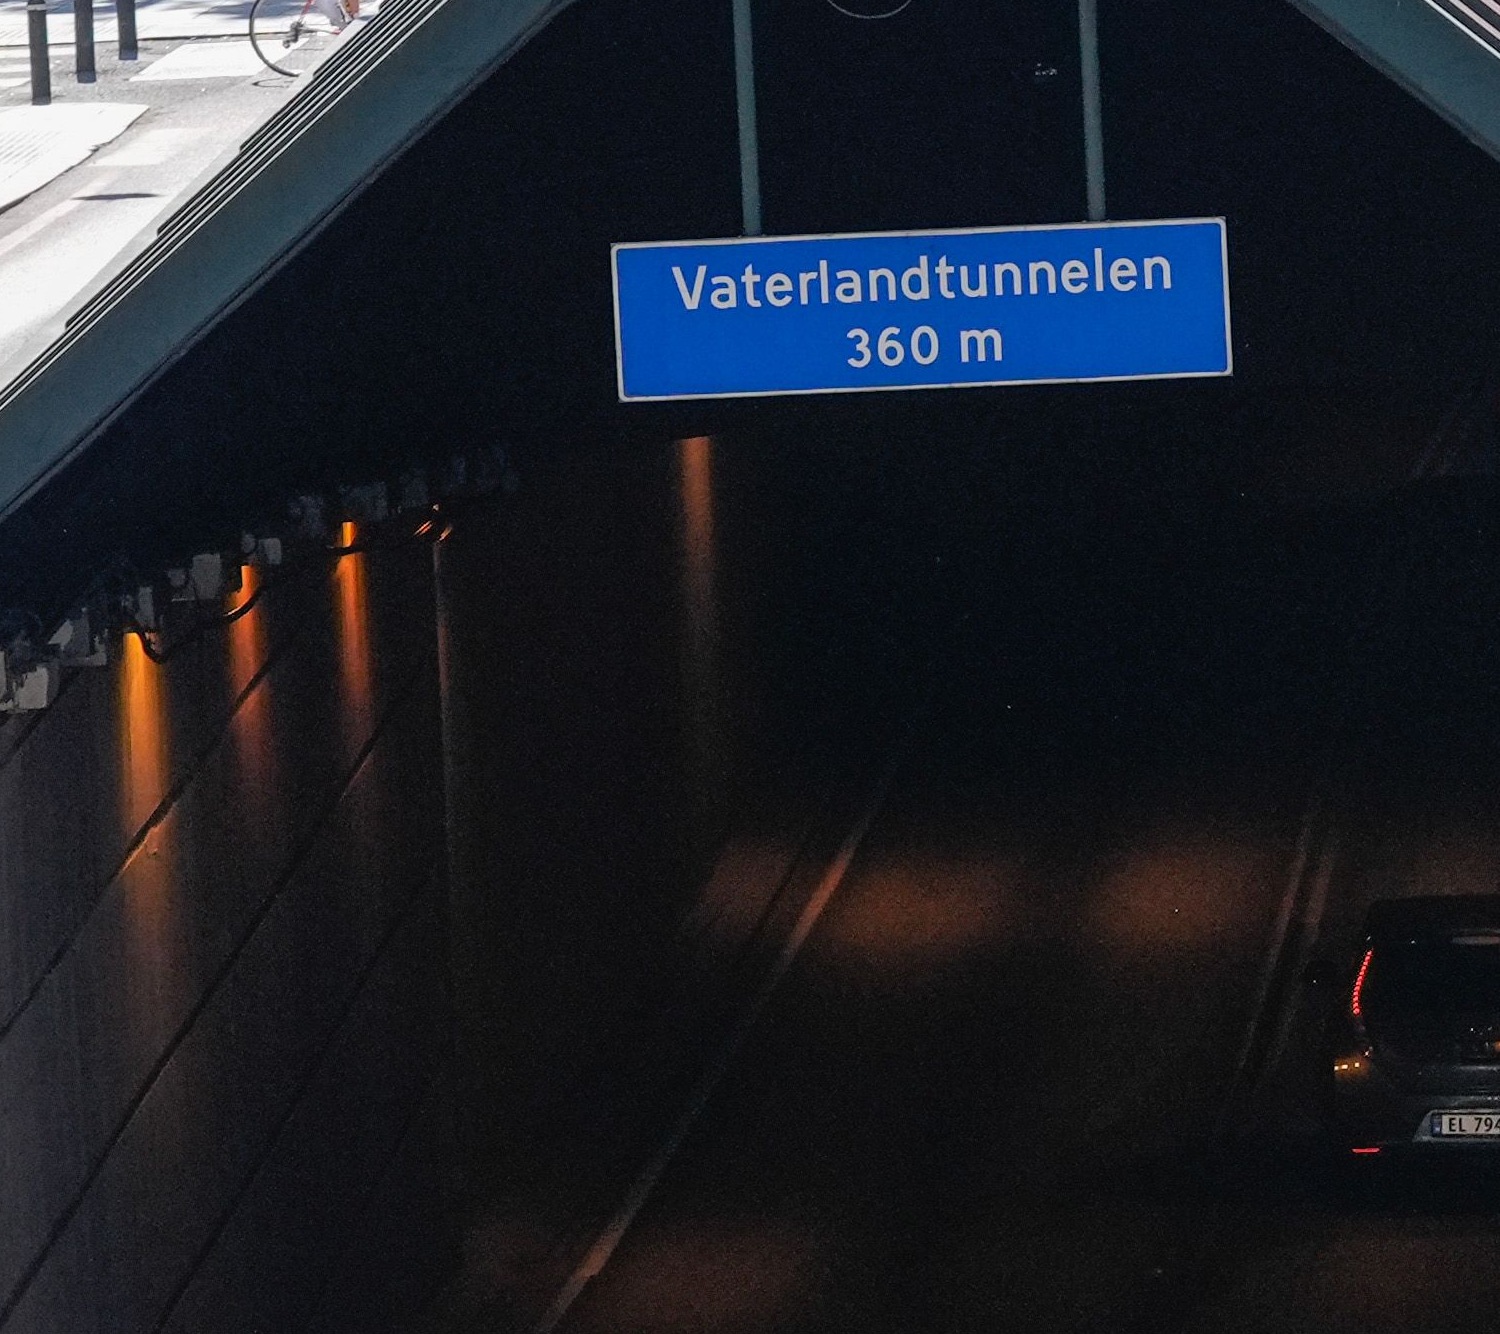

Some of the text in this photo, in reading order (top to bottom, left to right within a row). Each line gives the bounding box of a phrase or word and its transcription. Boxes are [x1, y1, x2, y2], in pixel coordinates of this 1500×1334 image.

[672, 248, 1172, 310] Vaterlandtunnelen
[846, 325, 1003, 369] 360 m
[1449, 1117, 1466, 1132] EL
